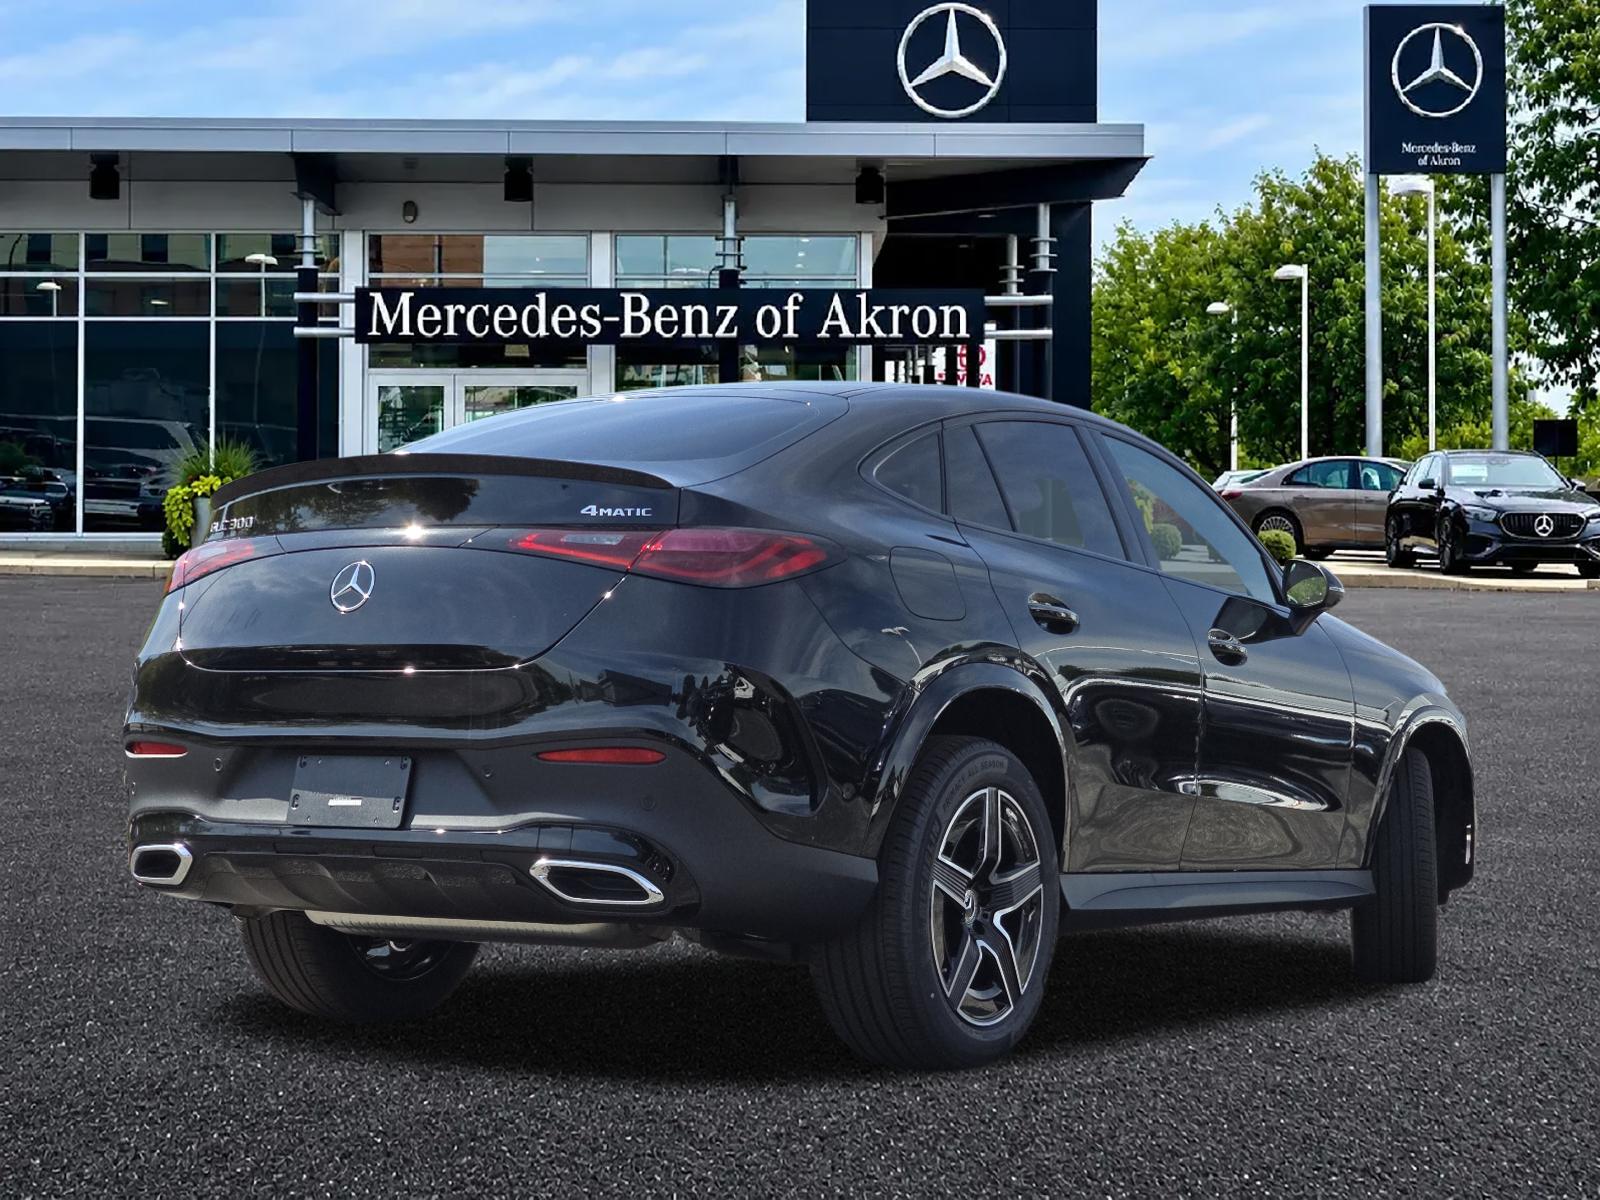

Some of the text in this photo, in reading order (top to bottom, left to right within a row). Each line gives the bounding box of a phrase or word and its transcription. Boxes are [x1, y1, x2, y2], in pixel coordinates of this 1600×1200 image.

[1401, 141, 1476, 154] Mercedes-Benz
[1417, 154, 1461, 166] of Akron
[367, 291, 970, 338] Mercedes-Benz of Akron
[580, 504, 652, 517] 4MATIC
